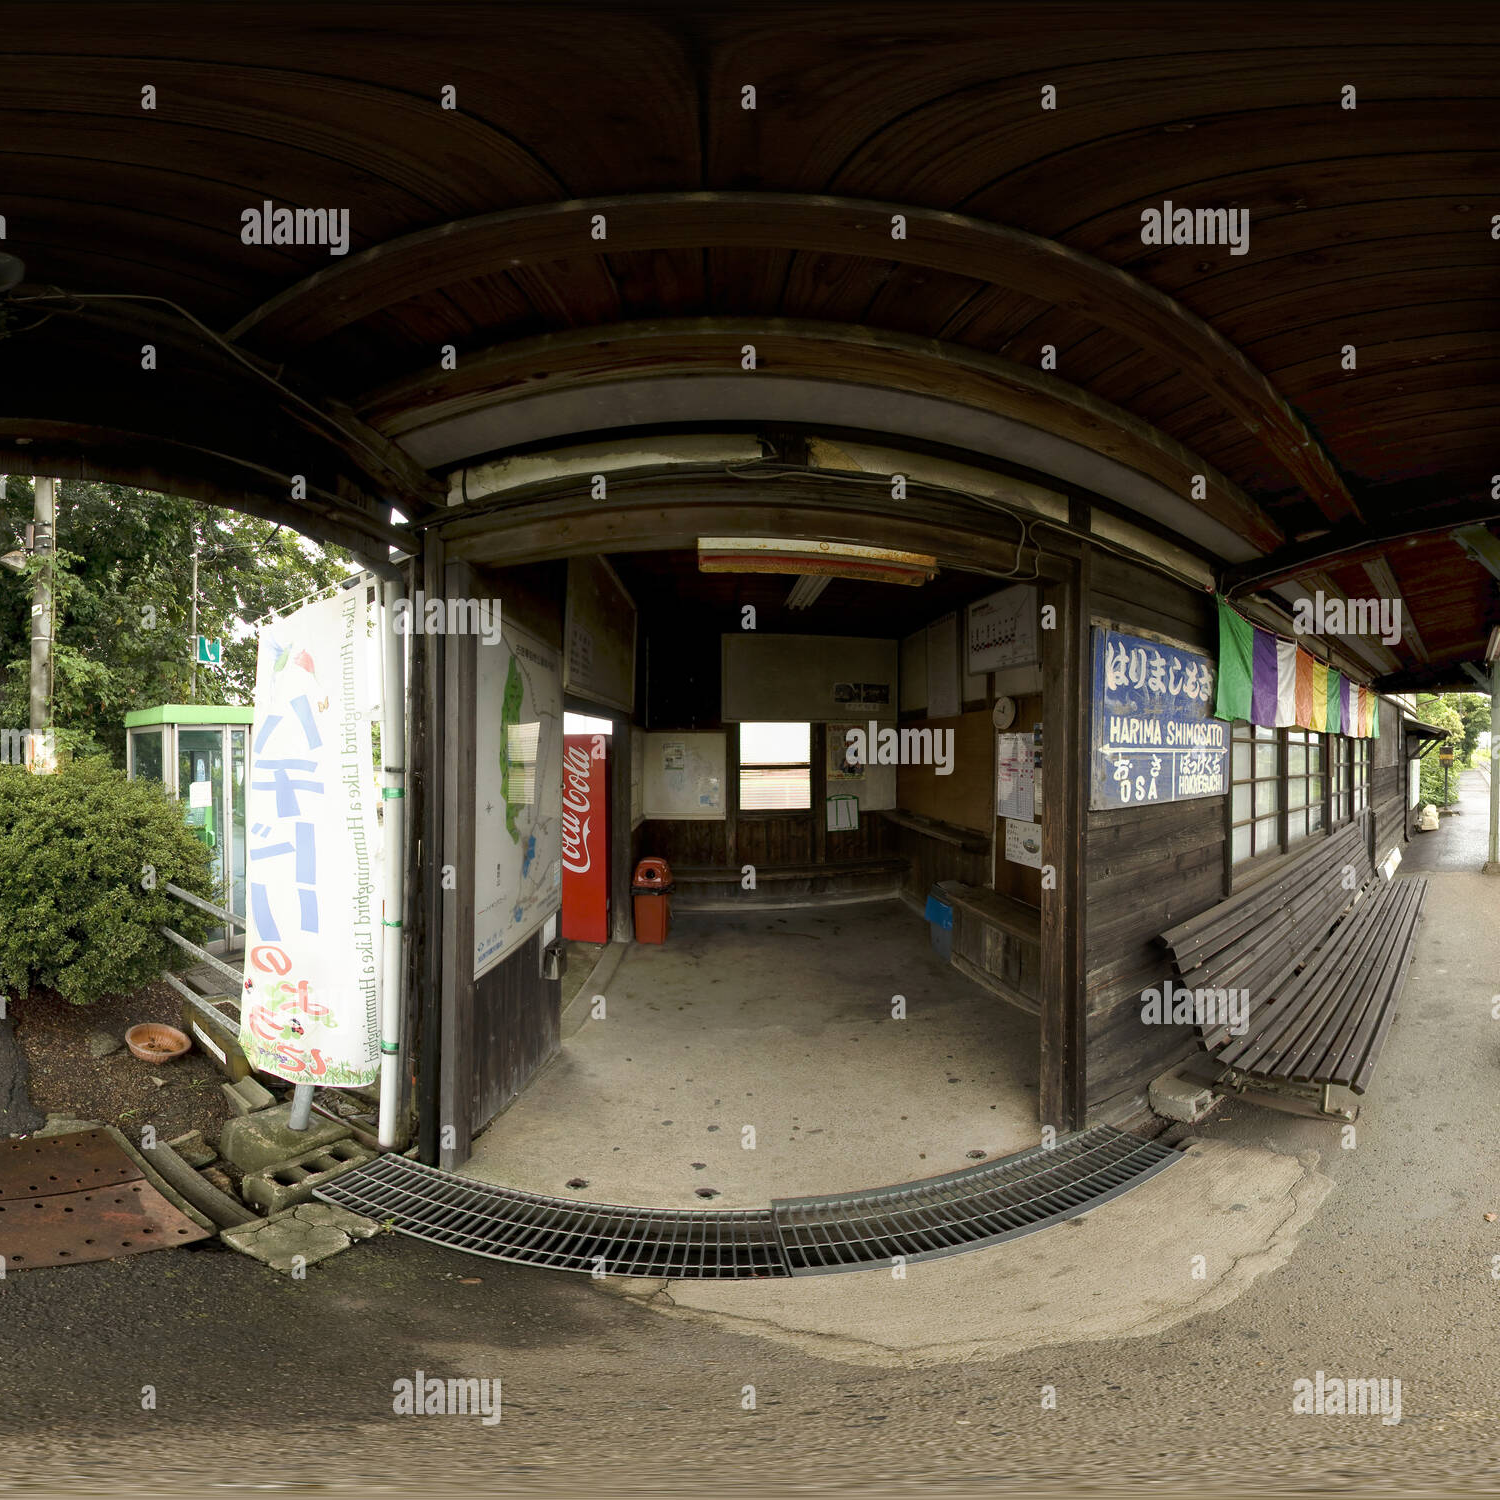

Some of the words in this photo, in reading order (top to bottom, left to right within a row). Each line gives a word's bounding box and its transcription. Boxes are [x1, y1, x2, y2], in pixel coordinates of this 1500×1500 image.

[1109, 716, 1162, 745] HARIMA
[1166, 720, 1223, 746] SHIMOSATO
[1120, 775, 1158, 803] OSA
[1178, 774, 1223, 795] HOKKEGUCHI
